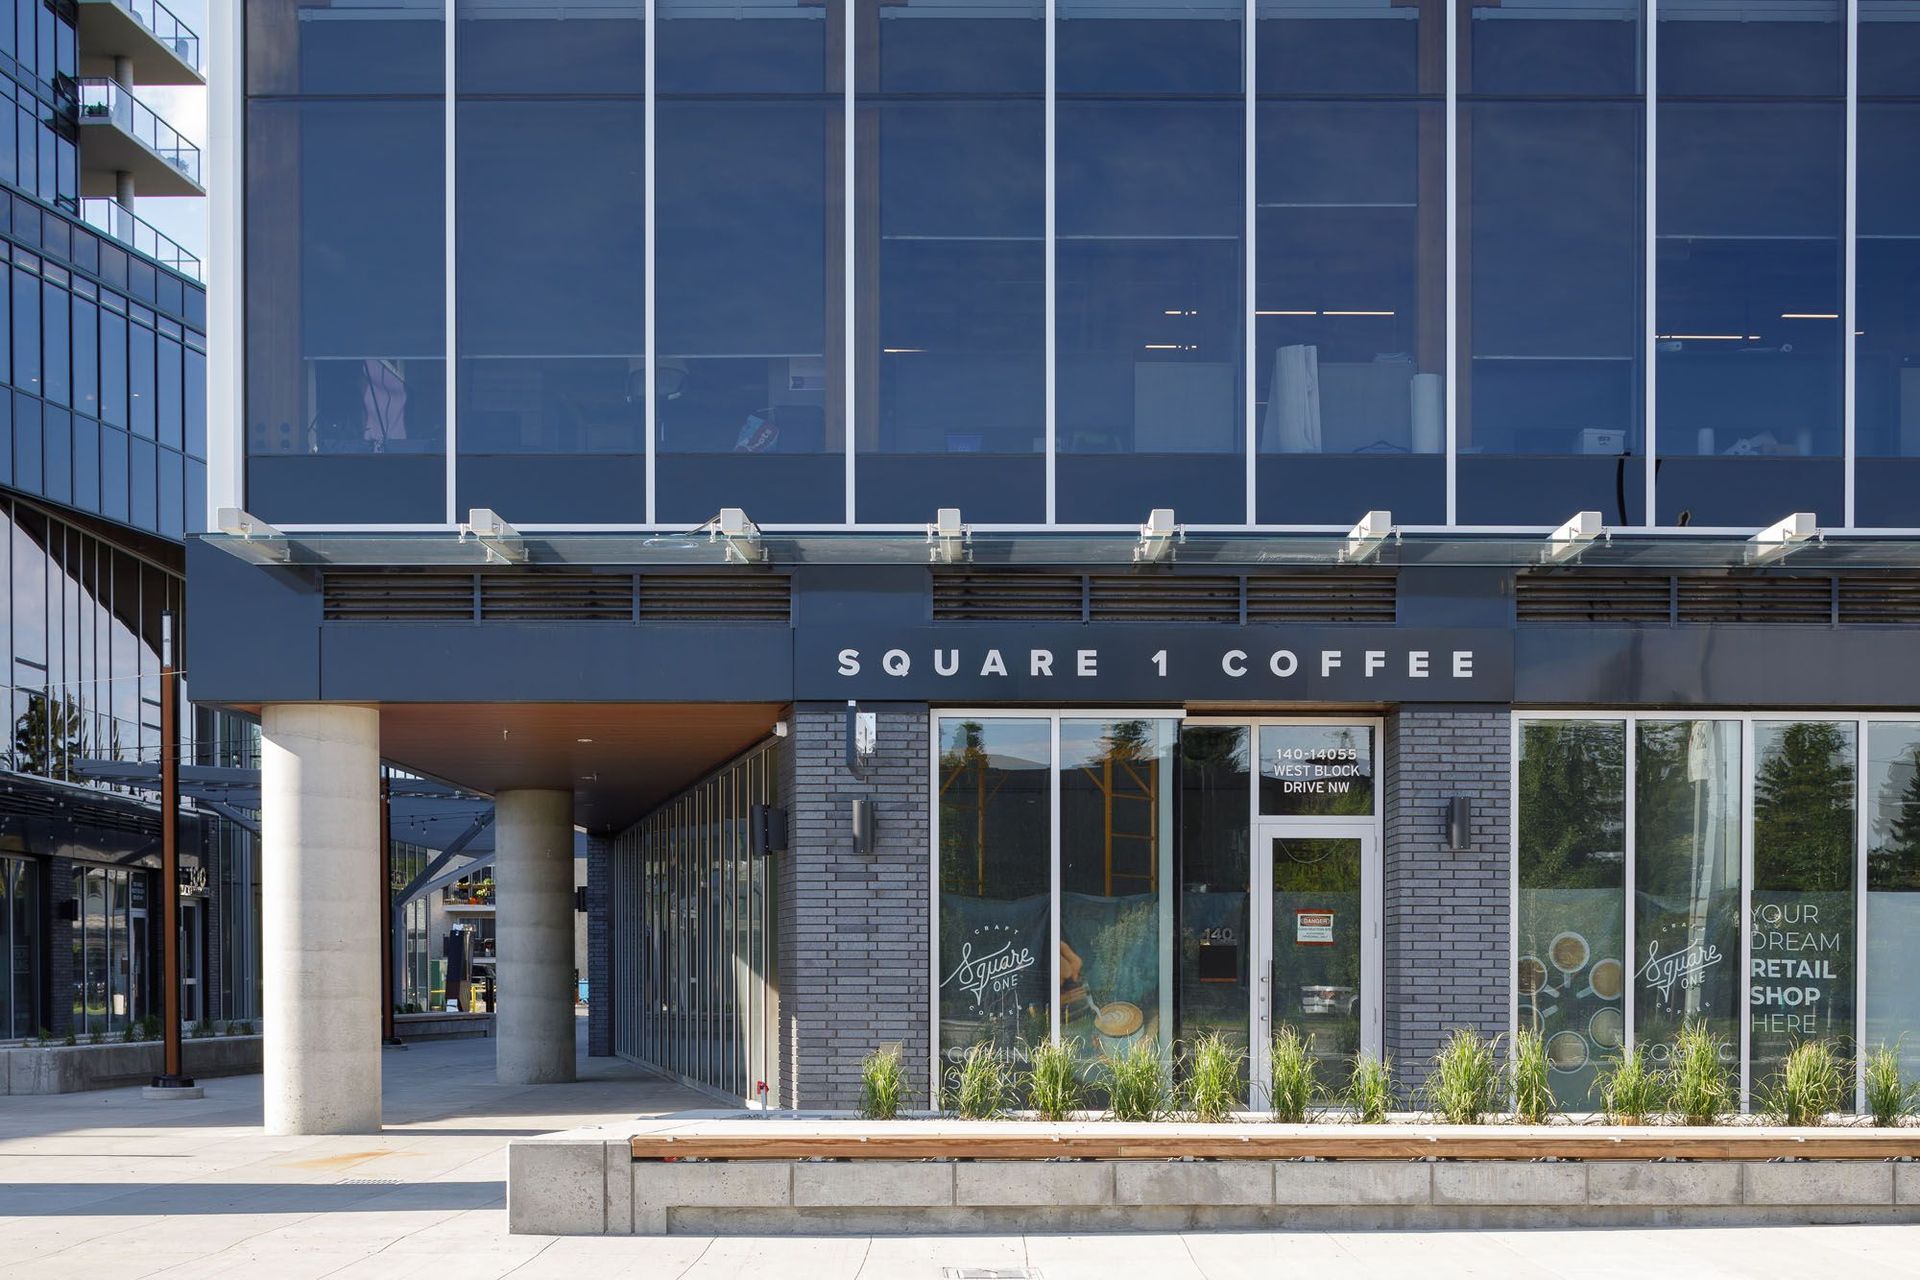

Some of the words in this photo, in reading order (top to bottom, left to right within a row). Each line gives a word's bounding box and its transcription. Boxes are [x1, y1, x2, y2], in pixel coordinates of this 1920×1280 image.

[838, 649, 1098, 678] SQUARE
[1151, 650, 1167, 677] 1
[1222, 649, 1473, 678] COFFEE
[1276, 748, 1357, 760] 140-14055
[1273, 765, 1310, 777] WEST
[1314, 765, 1360, 777] BLOCK
[1284, 781, 1325, 793] DRIVE
[1328, 781, 1350, 793] NW
[1302, 918, 1328, 926] DANGER
[1750, 904, 1819, 924] YOUR
[974, 924, 1019, 935] CRAFT
[1750, 931, 1840, 952] DREAM
[940, 941, 1035, 1006] Square
[1634, 939, 1722, 1003] Square
[1750, 958, 1837, 979] RETAIL
[993, 974, 1018, 992] ONE
[1681, 971, 1706, 989] ONE
[1750, 985, 1821, 1006] SHOP
[1751, 1013, 1817, 1034] HERE
